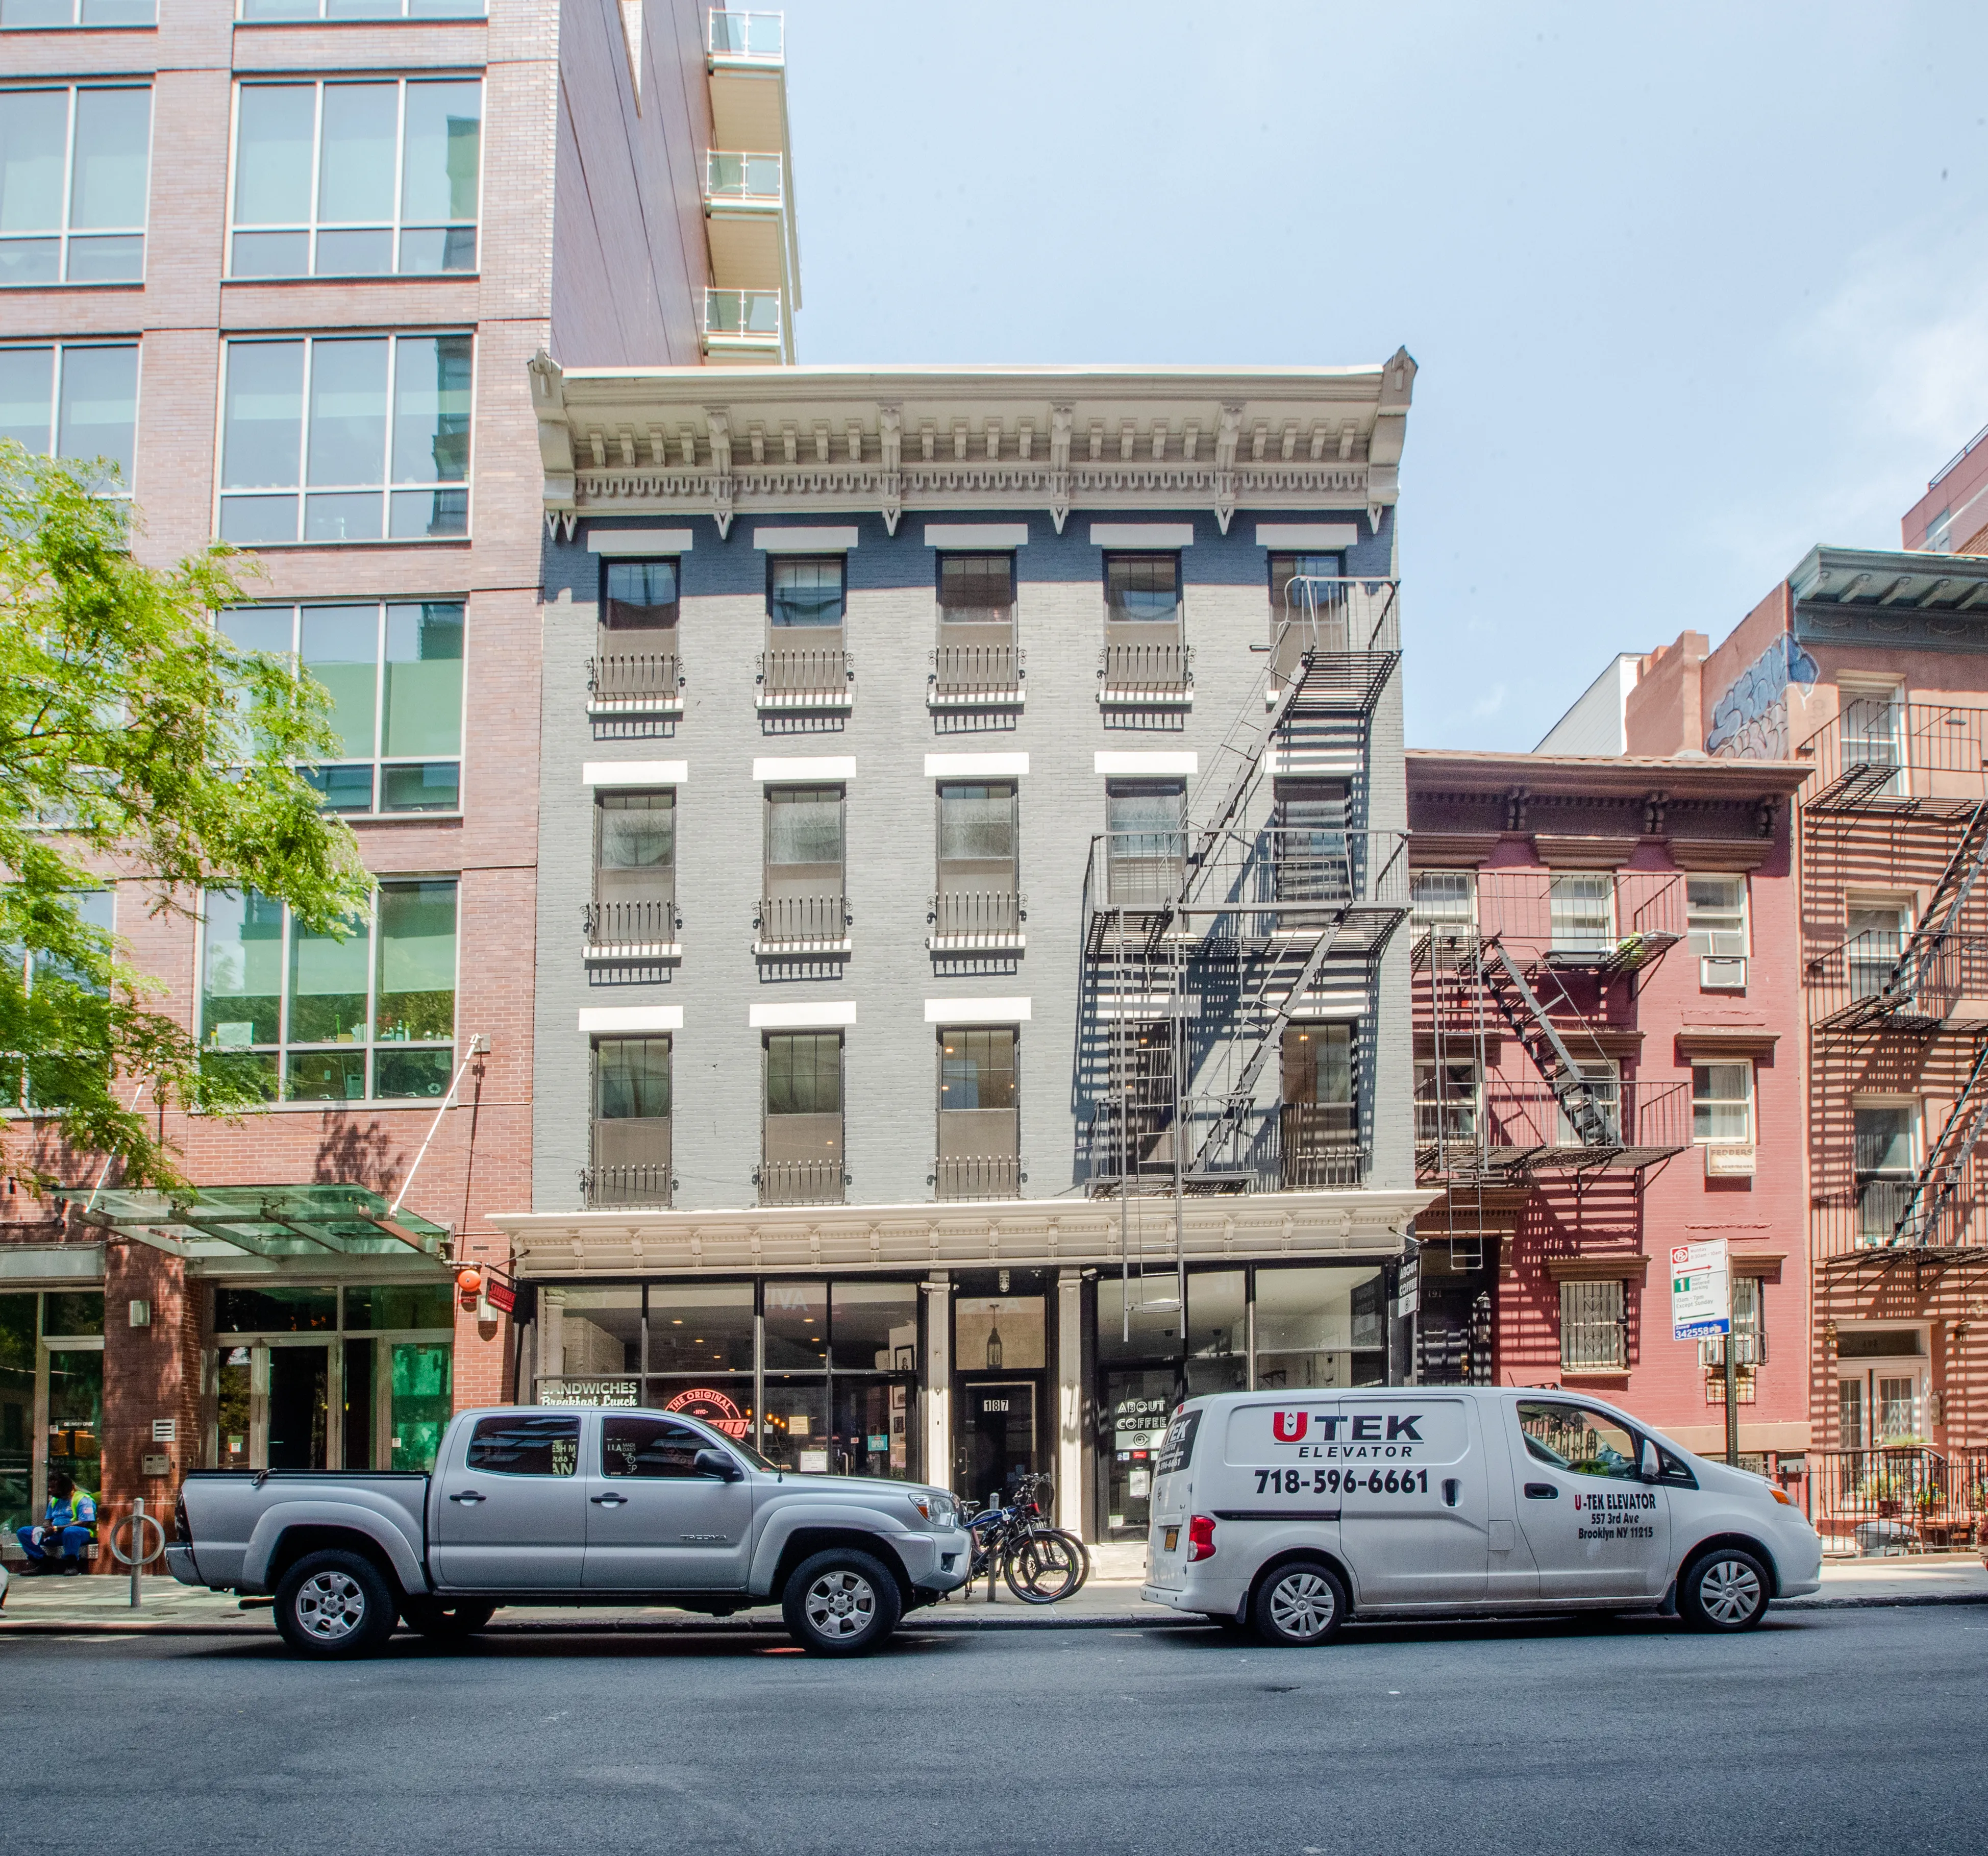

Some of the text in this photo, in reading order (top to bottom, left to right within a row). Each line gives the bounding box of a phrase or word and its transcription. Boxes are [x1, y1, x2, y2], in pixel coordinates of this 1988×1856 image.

[1399, 1259, 1418, 1280] ABOUT
[1399, 1277, 1418, 1297] COFFEE
[1678, 1278, 1684, 1292] 1
[1676, 1327, 1709, 1339] 342558
[541, 1382, 637, 1395] SANDWICHES
[540, 1395, 638, 1407] Breakfast Lunch
[669, 1391, 732, 1411] THE ORIGINAL
[985, 1400, 1008, 1411] 187
[1117, 1400, 1165, 1414] ABOUT
[1116, 1417, 1167, 1430] COFFEE
[1165, 1419, 1192, 1444] TEK
[1298, 1446, 1412, 1458] ELEVATOR
[1254, 1468, 1428, 1494] 718-596-6661
[1575, 1493, 1656, 1511] U-TEK ELEVATOR
[1591, 1513, 1639, 1524] 557 3rd Ave
[1578, 1526, 1653, 1541] Brooklyn NY 11215
